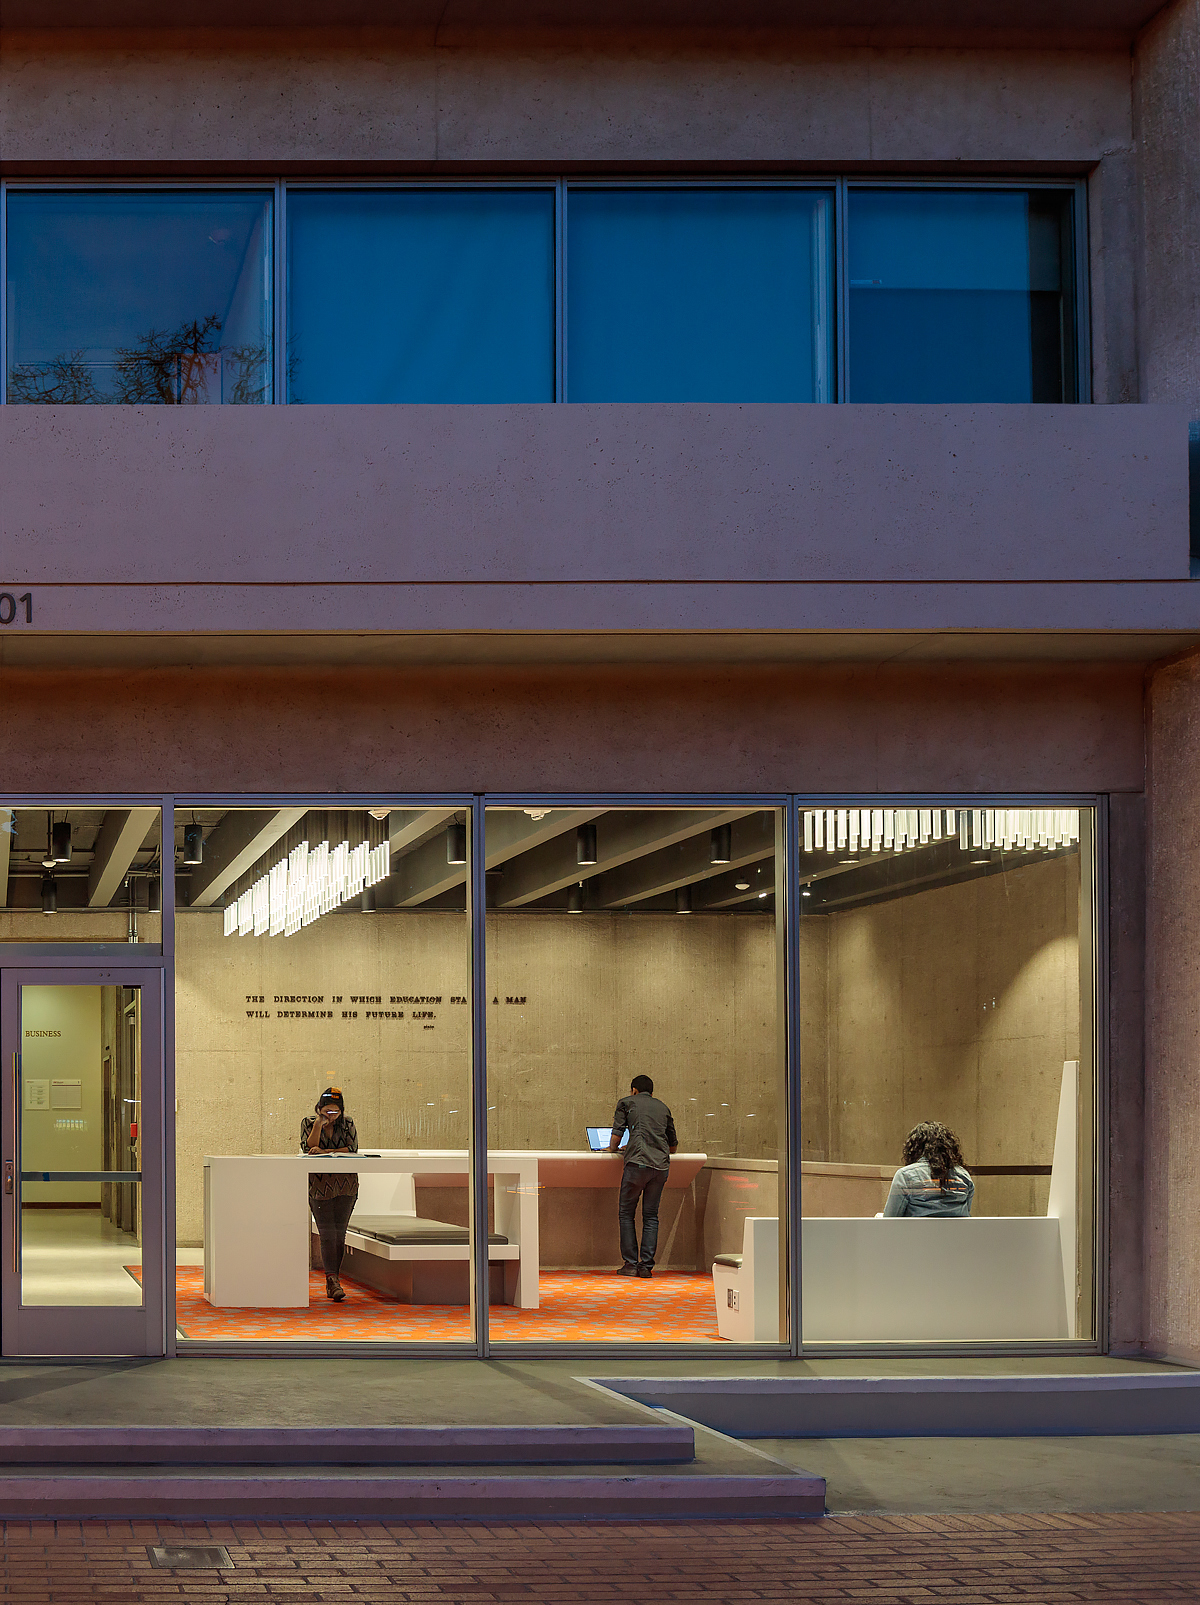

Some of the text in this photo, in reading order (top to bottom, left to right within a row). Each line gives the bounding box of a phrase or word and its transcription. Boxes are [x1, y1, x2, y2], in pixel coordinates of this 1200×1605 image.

[245, 995, 265, 1003] THE
[273, 995, 324, 1003] DIRECTION
[350, 996, 382, 1004] WHICH
[390, 996, 442, 1004] EDUCATION
[492, 996, 499, 1004] A
[505, 996, 527, 1004] MAN
[25, 1030, 62, 1038] BUSINESS
